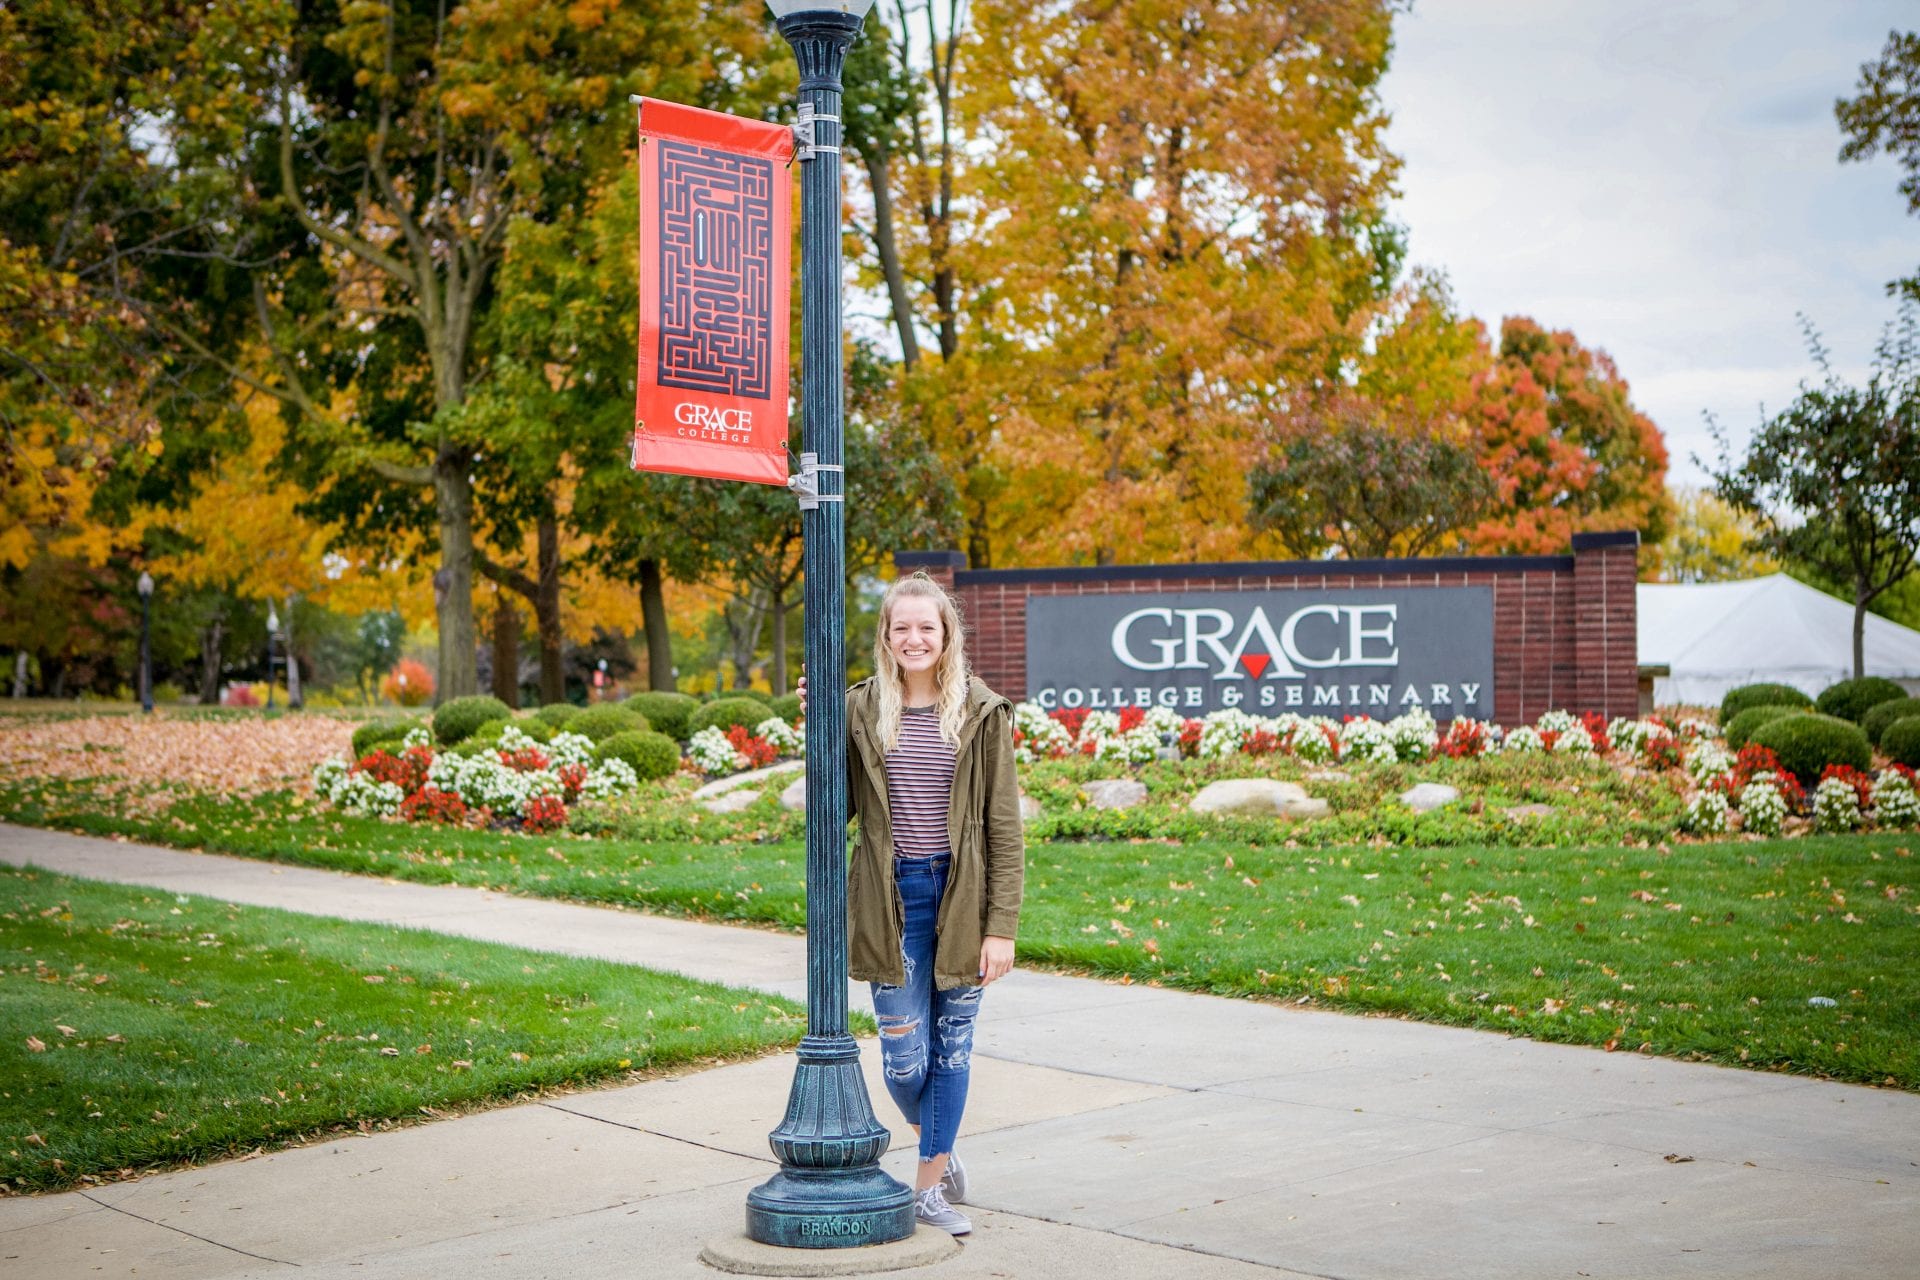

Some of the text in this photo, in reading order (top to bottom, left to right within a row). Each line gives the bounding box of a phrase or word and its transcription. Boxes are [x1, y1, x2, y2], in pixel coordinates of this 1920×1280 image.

[674, 402, 752, 432] GRACE
[678, 428, 750, 443] COLLEGE
[1111, 603, 1399, 681] GRACE
[1038, 682, 1481, 708] COLLEGE & SEMINARY
[801, 1220, 871, 1236] BRANDON
